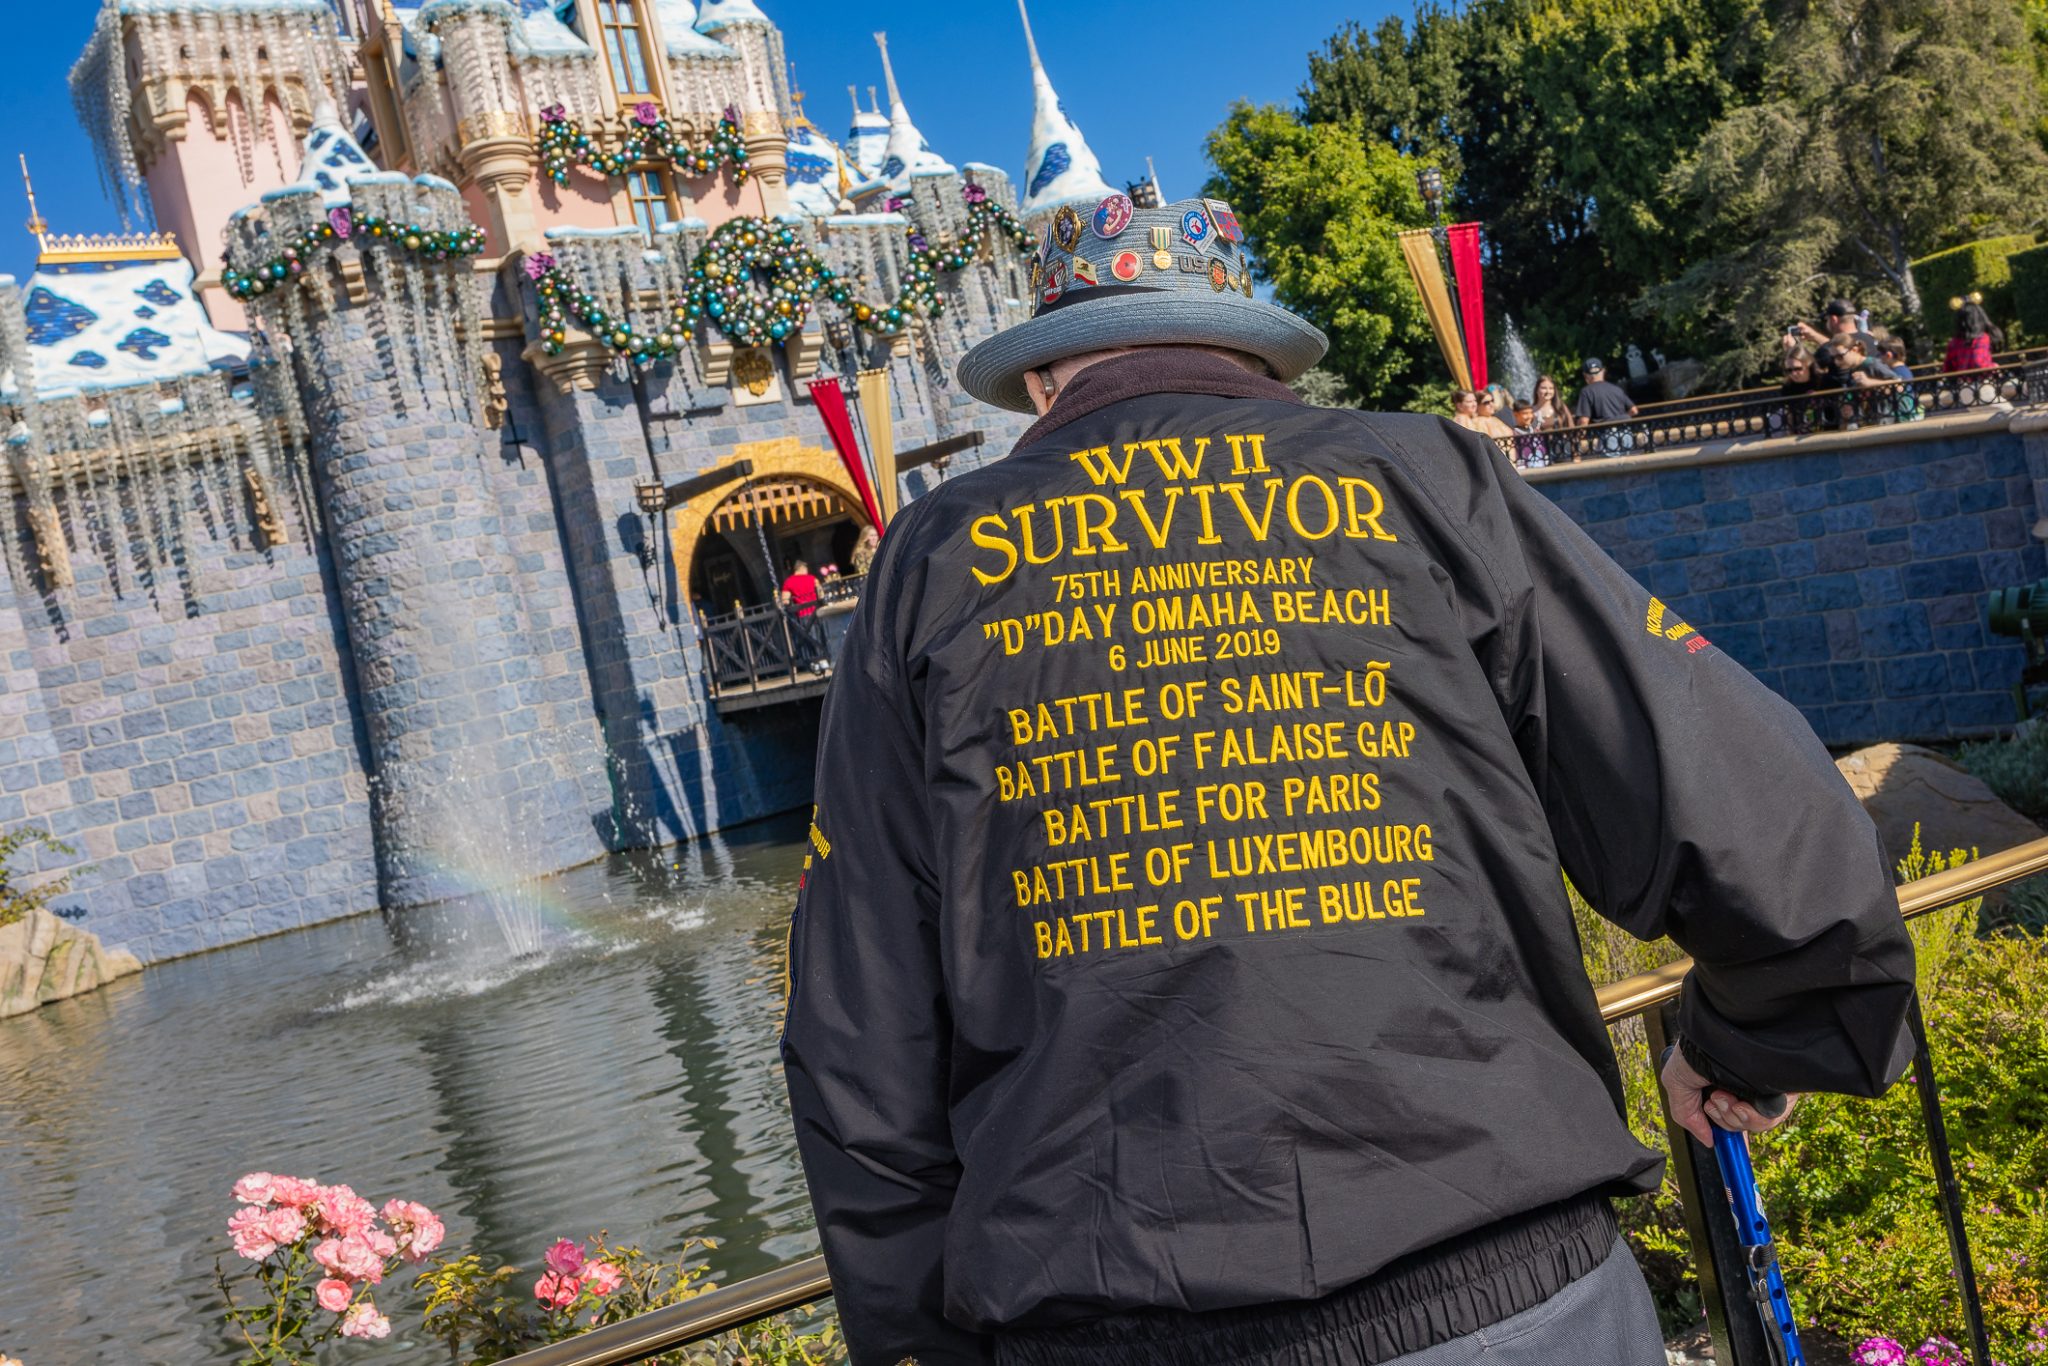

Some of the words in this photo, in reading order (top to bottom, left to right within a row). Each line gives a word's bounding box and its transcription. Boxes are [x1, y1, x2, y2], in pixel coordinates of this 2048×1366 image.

[1224, 433, 1271, 476] II
[969, 473, 1398, 587] SURVIVOR
[1052, 569, 1121, 603] 75TH
[1130, 556, 1314, 595] ANNIVERSARY
[1131, 590, 1264, 635] OMAHA
[1271, 588, 1391, 627] BEACH
[1108, 645, 1127, 673] 6
[1136, 634, 1207, 669] JUNE
[1215, 628, 1281, 661] 2019
[1008, 688, 1149, 746] BATTLE
[1159, 680, 1207, 721] OF
[995, 744, 1121, 802] BATTLE
[1131, 735, 1181, 777] OF
[1193, 721, 1350, 770] FALAISE
[1356, 720, 1416, 759] GAP
[1043, 789, 1184, 847] BATTLE
[1195, 780, 1269, 825] FOR
[1282, 772, 1382, 818] PARIS
[1012, 852, 1134, 908] BATTLE
[1144, 842, 1193, 887] OF
[1207, 823, 1435, 880] LUXEMBOURG
[1034, 904, 1163, 960] BATTLE
[1173, 896, 1223, 941] OF
[1234, 887, 1311, 933] THE
[1317, 877, 1425, 926] BULGE
